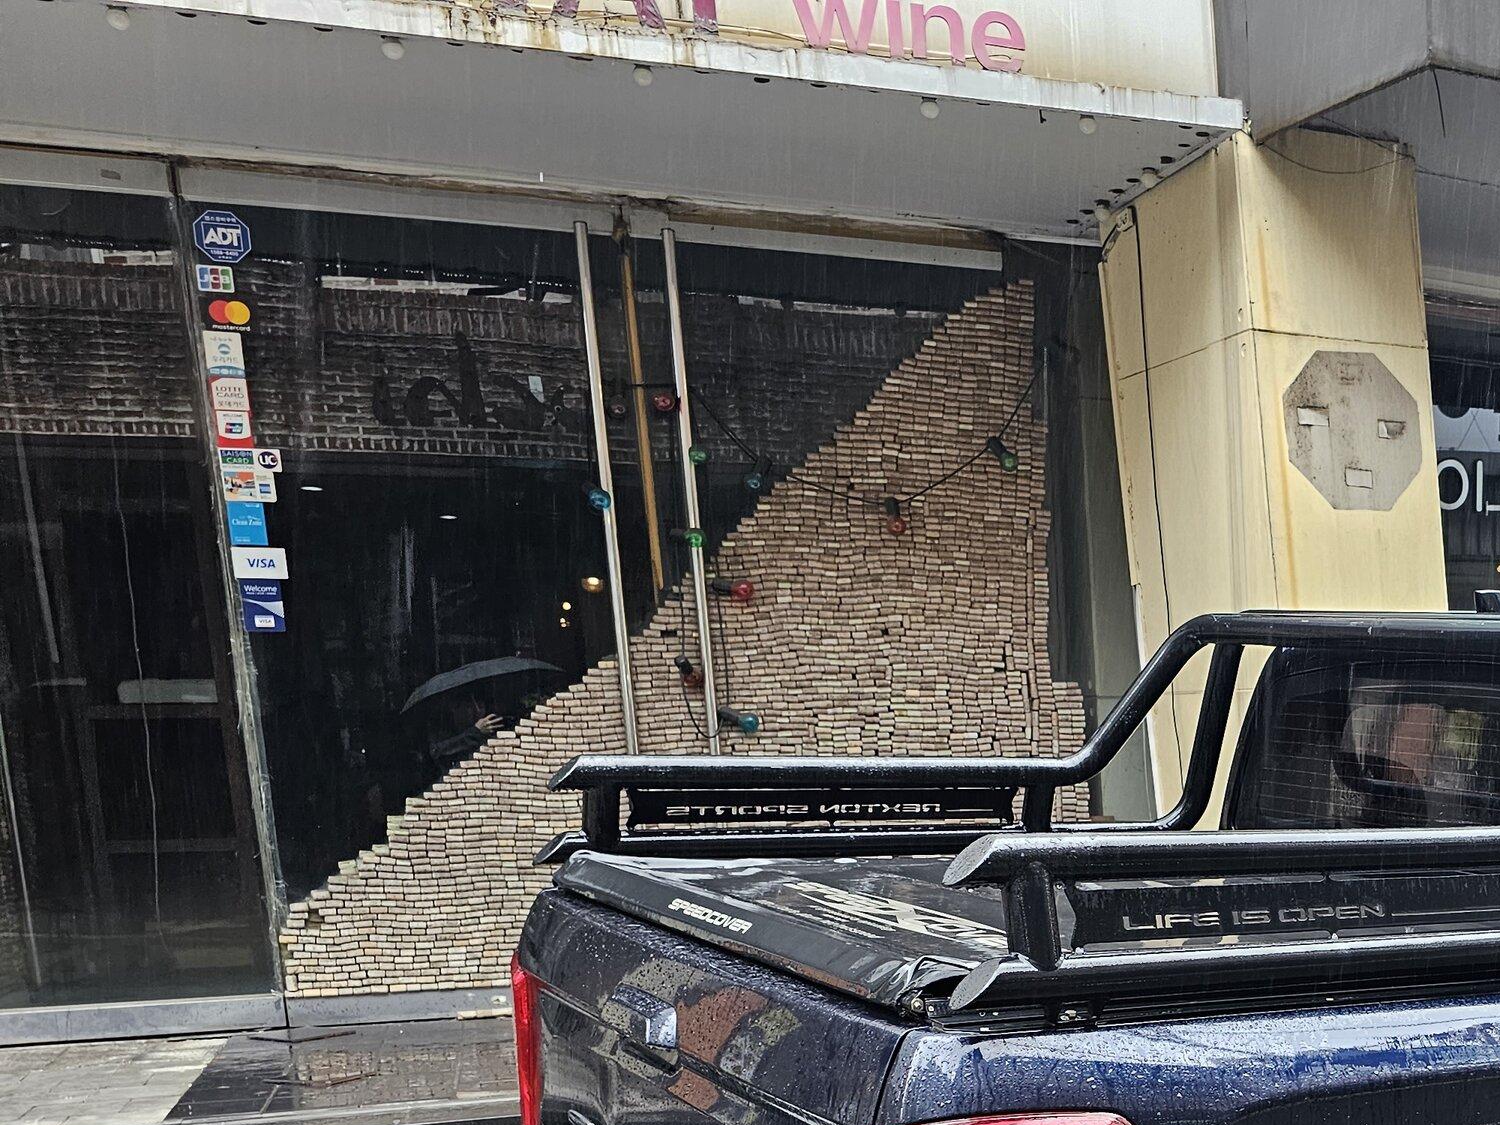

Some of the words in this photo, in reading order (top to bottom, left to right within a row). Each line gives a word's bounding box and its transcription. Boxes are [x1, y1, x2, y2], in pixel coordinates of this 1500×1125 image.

[204, 227, 241, 247] ADT
[212, 324, 251, 332] mastercard
[259, 455, 278, 466] UC
[247, 558, 276, 568] VISA
[243, 585, 278, 593] Welcome
[668, 898, 753, 935] SPEEDCOVER
[1122, 911, 1220, 931] LIFE
[1231, 910, 1271, 926] IS
[1278, 904, 1386, 923] OPEN
